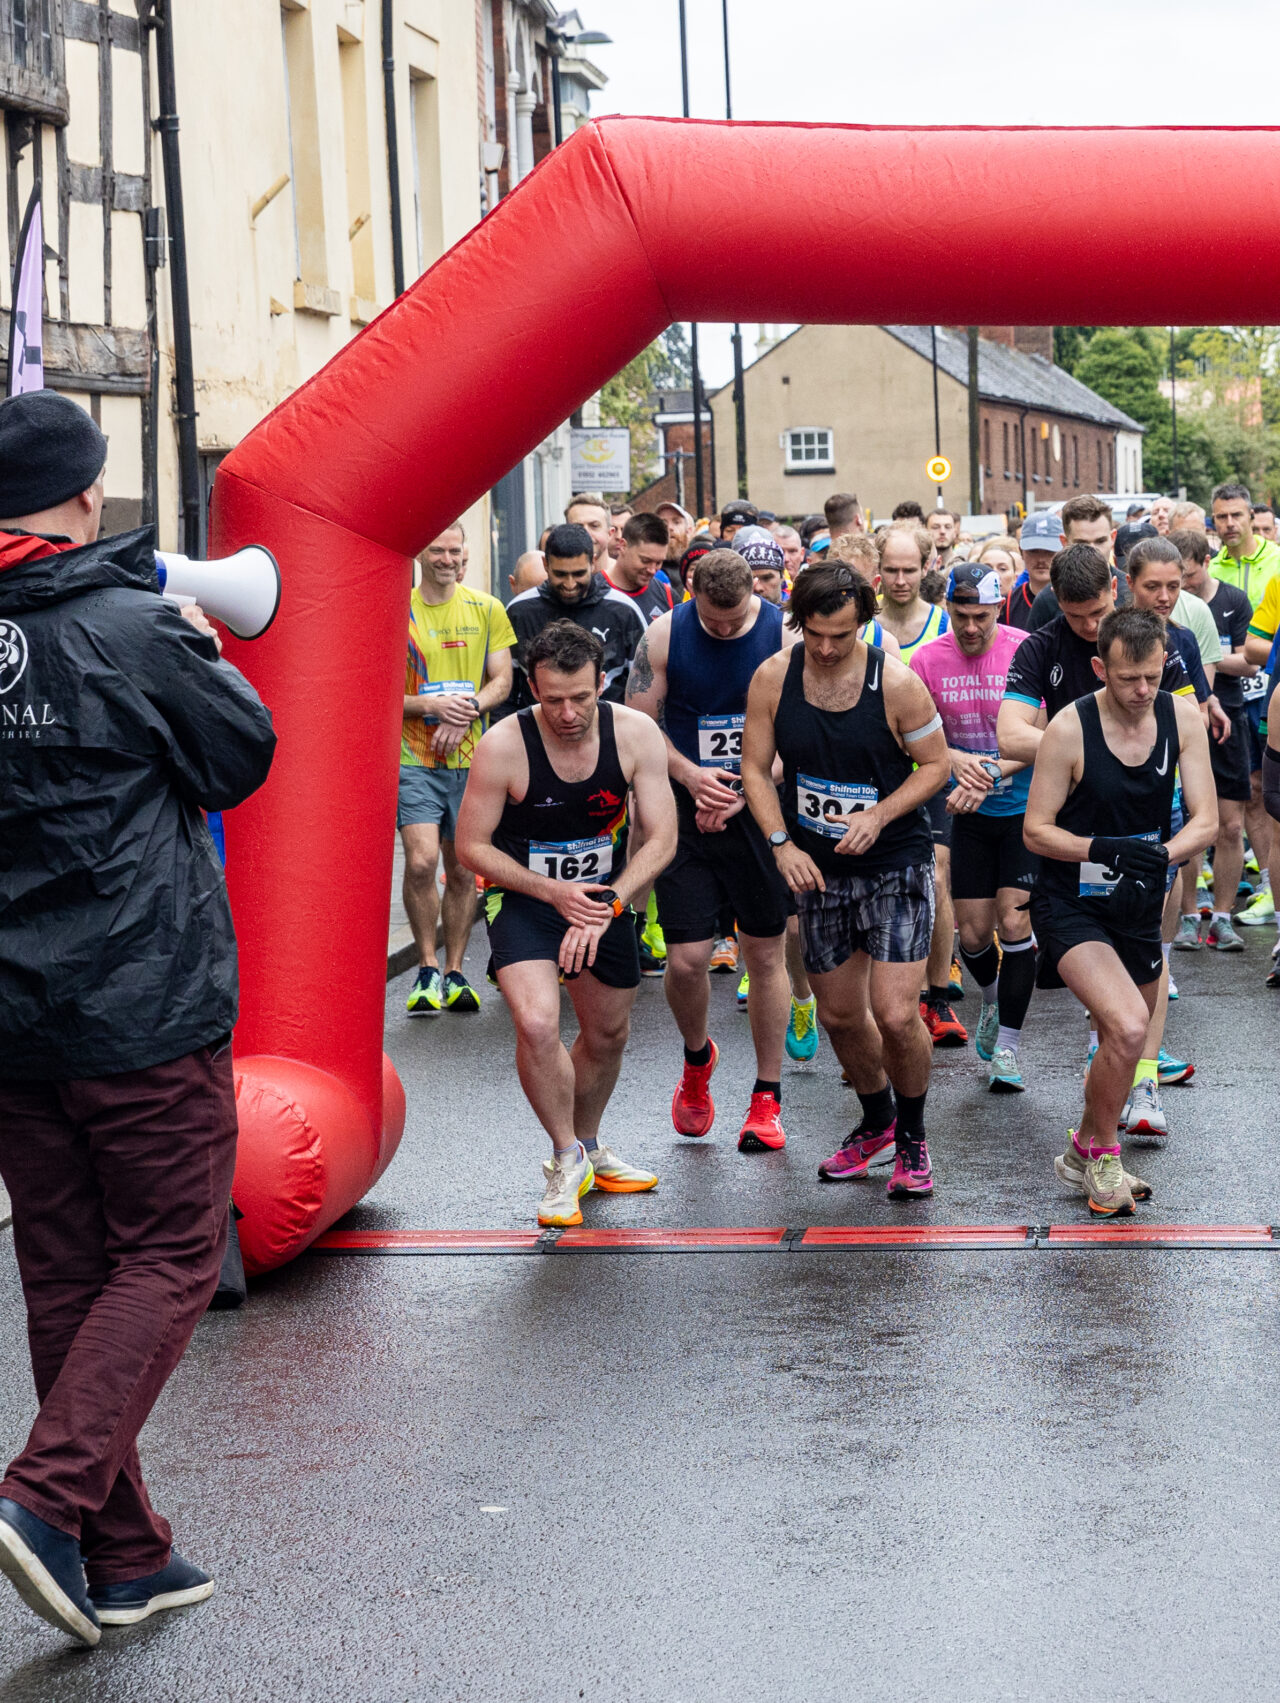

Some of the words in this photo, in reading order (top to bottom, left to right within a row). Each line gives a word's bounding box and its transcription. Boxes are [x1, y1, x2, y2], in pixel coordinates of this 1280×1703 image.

[942, 674, 982, 688] TOTAL
[1, 704, 56, 725] NAL
[830, 785, 860, 793] Shifnal
[861, 787, 876, 795] 10k
[567, 841, 597, 850] Shifnal
[545, 853, 598, 880] 162
